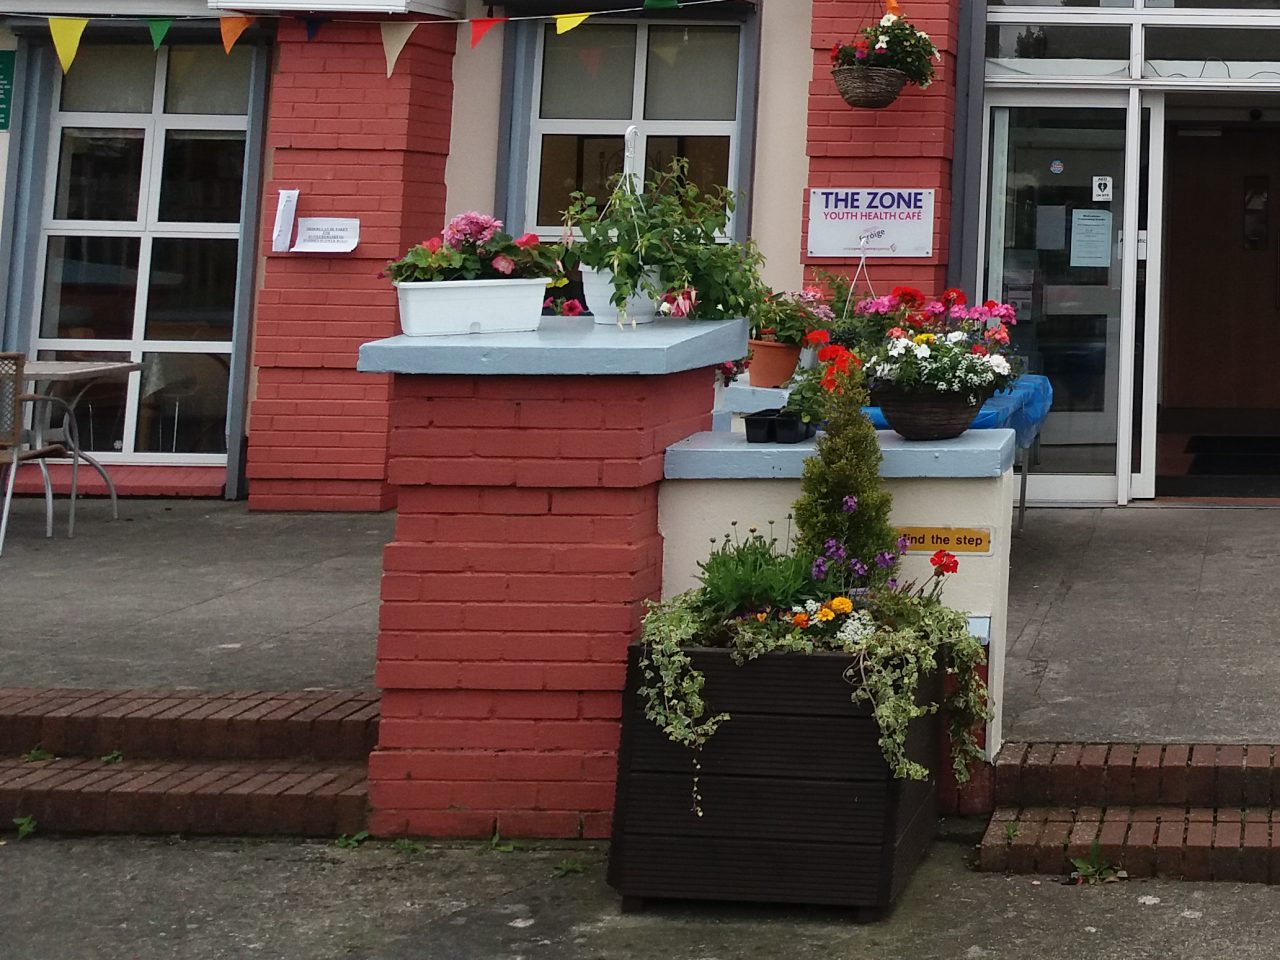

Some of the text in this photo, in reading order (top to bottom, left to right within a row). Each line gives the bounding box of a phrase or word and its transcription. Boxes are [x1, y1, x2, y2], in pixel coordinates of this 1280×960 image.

[821, 192, 923, 210] THE ZONE
[823, 210, 922, 220] YOUTH HEALTH CAFÉ
[897, 533, 983, 547] ind the step
